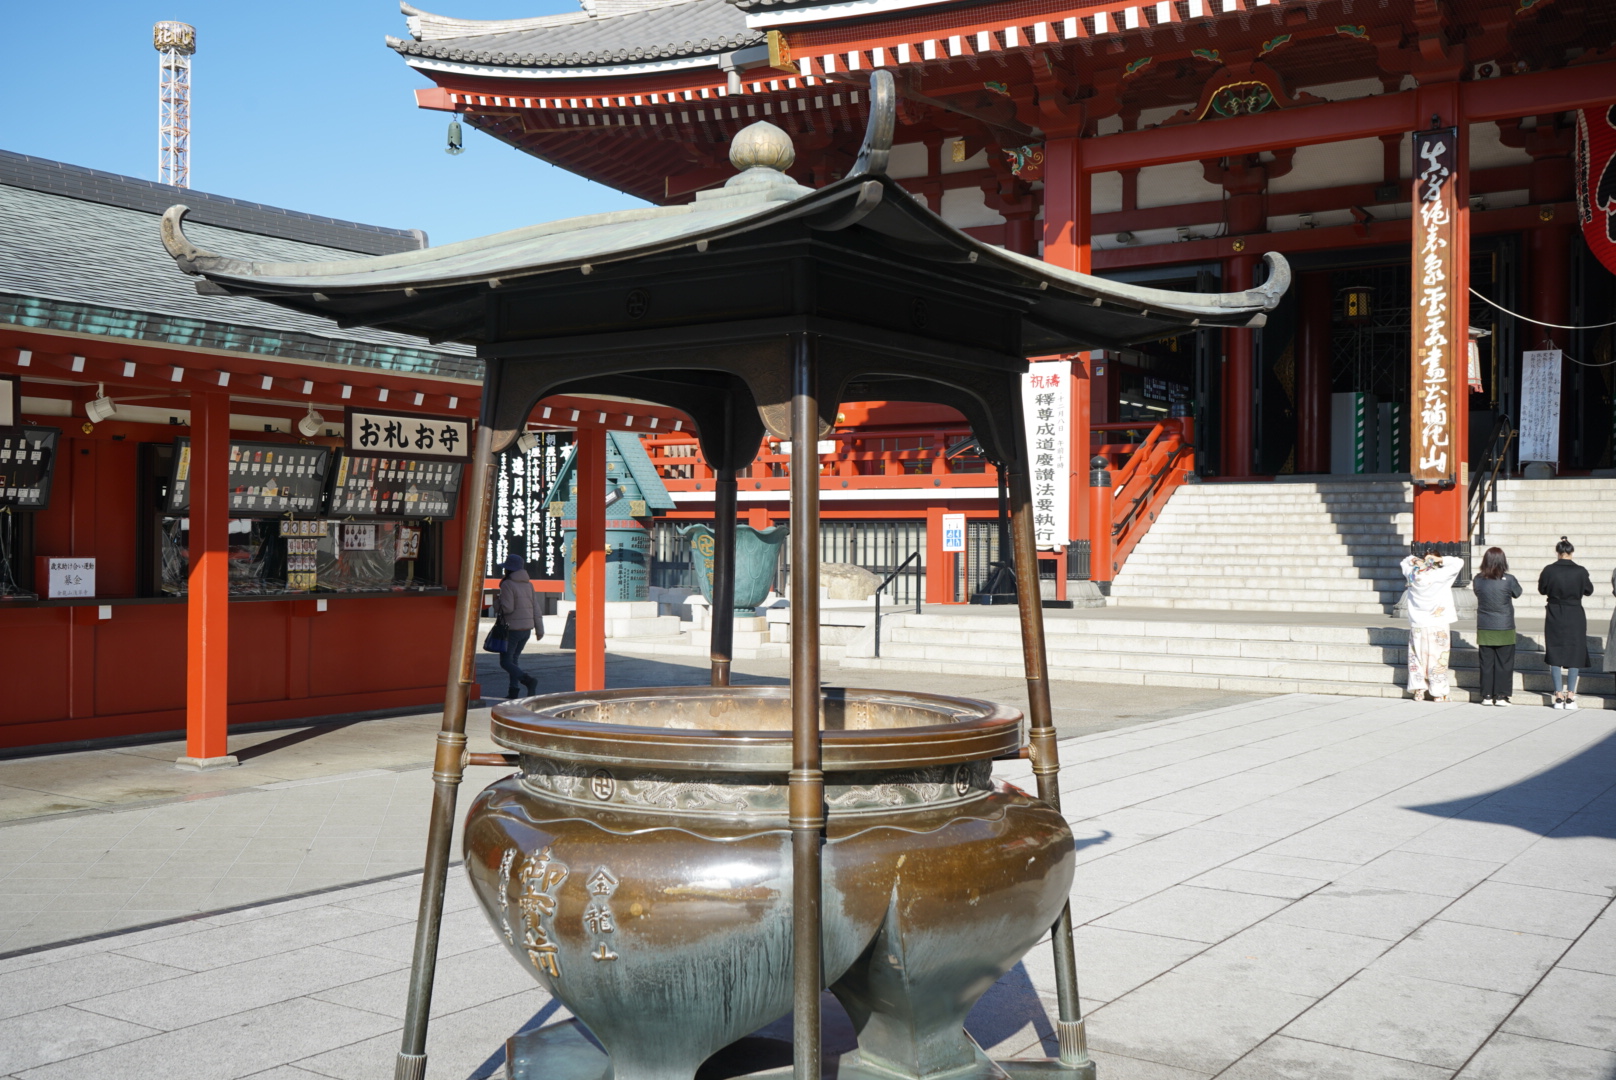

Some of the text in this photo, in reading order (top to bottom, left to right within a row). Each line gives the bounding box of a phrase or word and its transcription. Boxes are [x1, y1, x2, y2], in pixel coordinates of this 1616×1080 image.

[359, 418, 460, 453] お札お守
[1057, 394, 1065, 469] 十二月八日 午前十時
[64, 574, 82, 585] 募金
[584, 866, 619, 962] 金龍山
